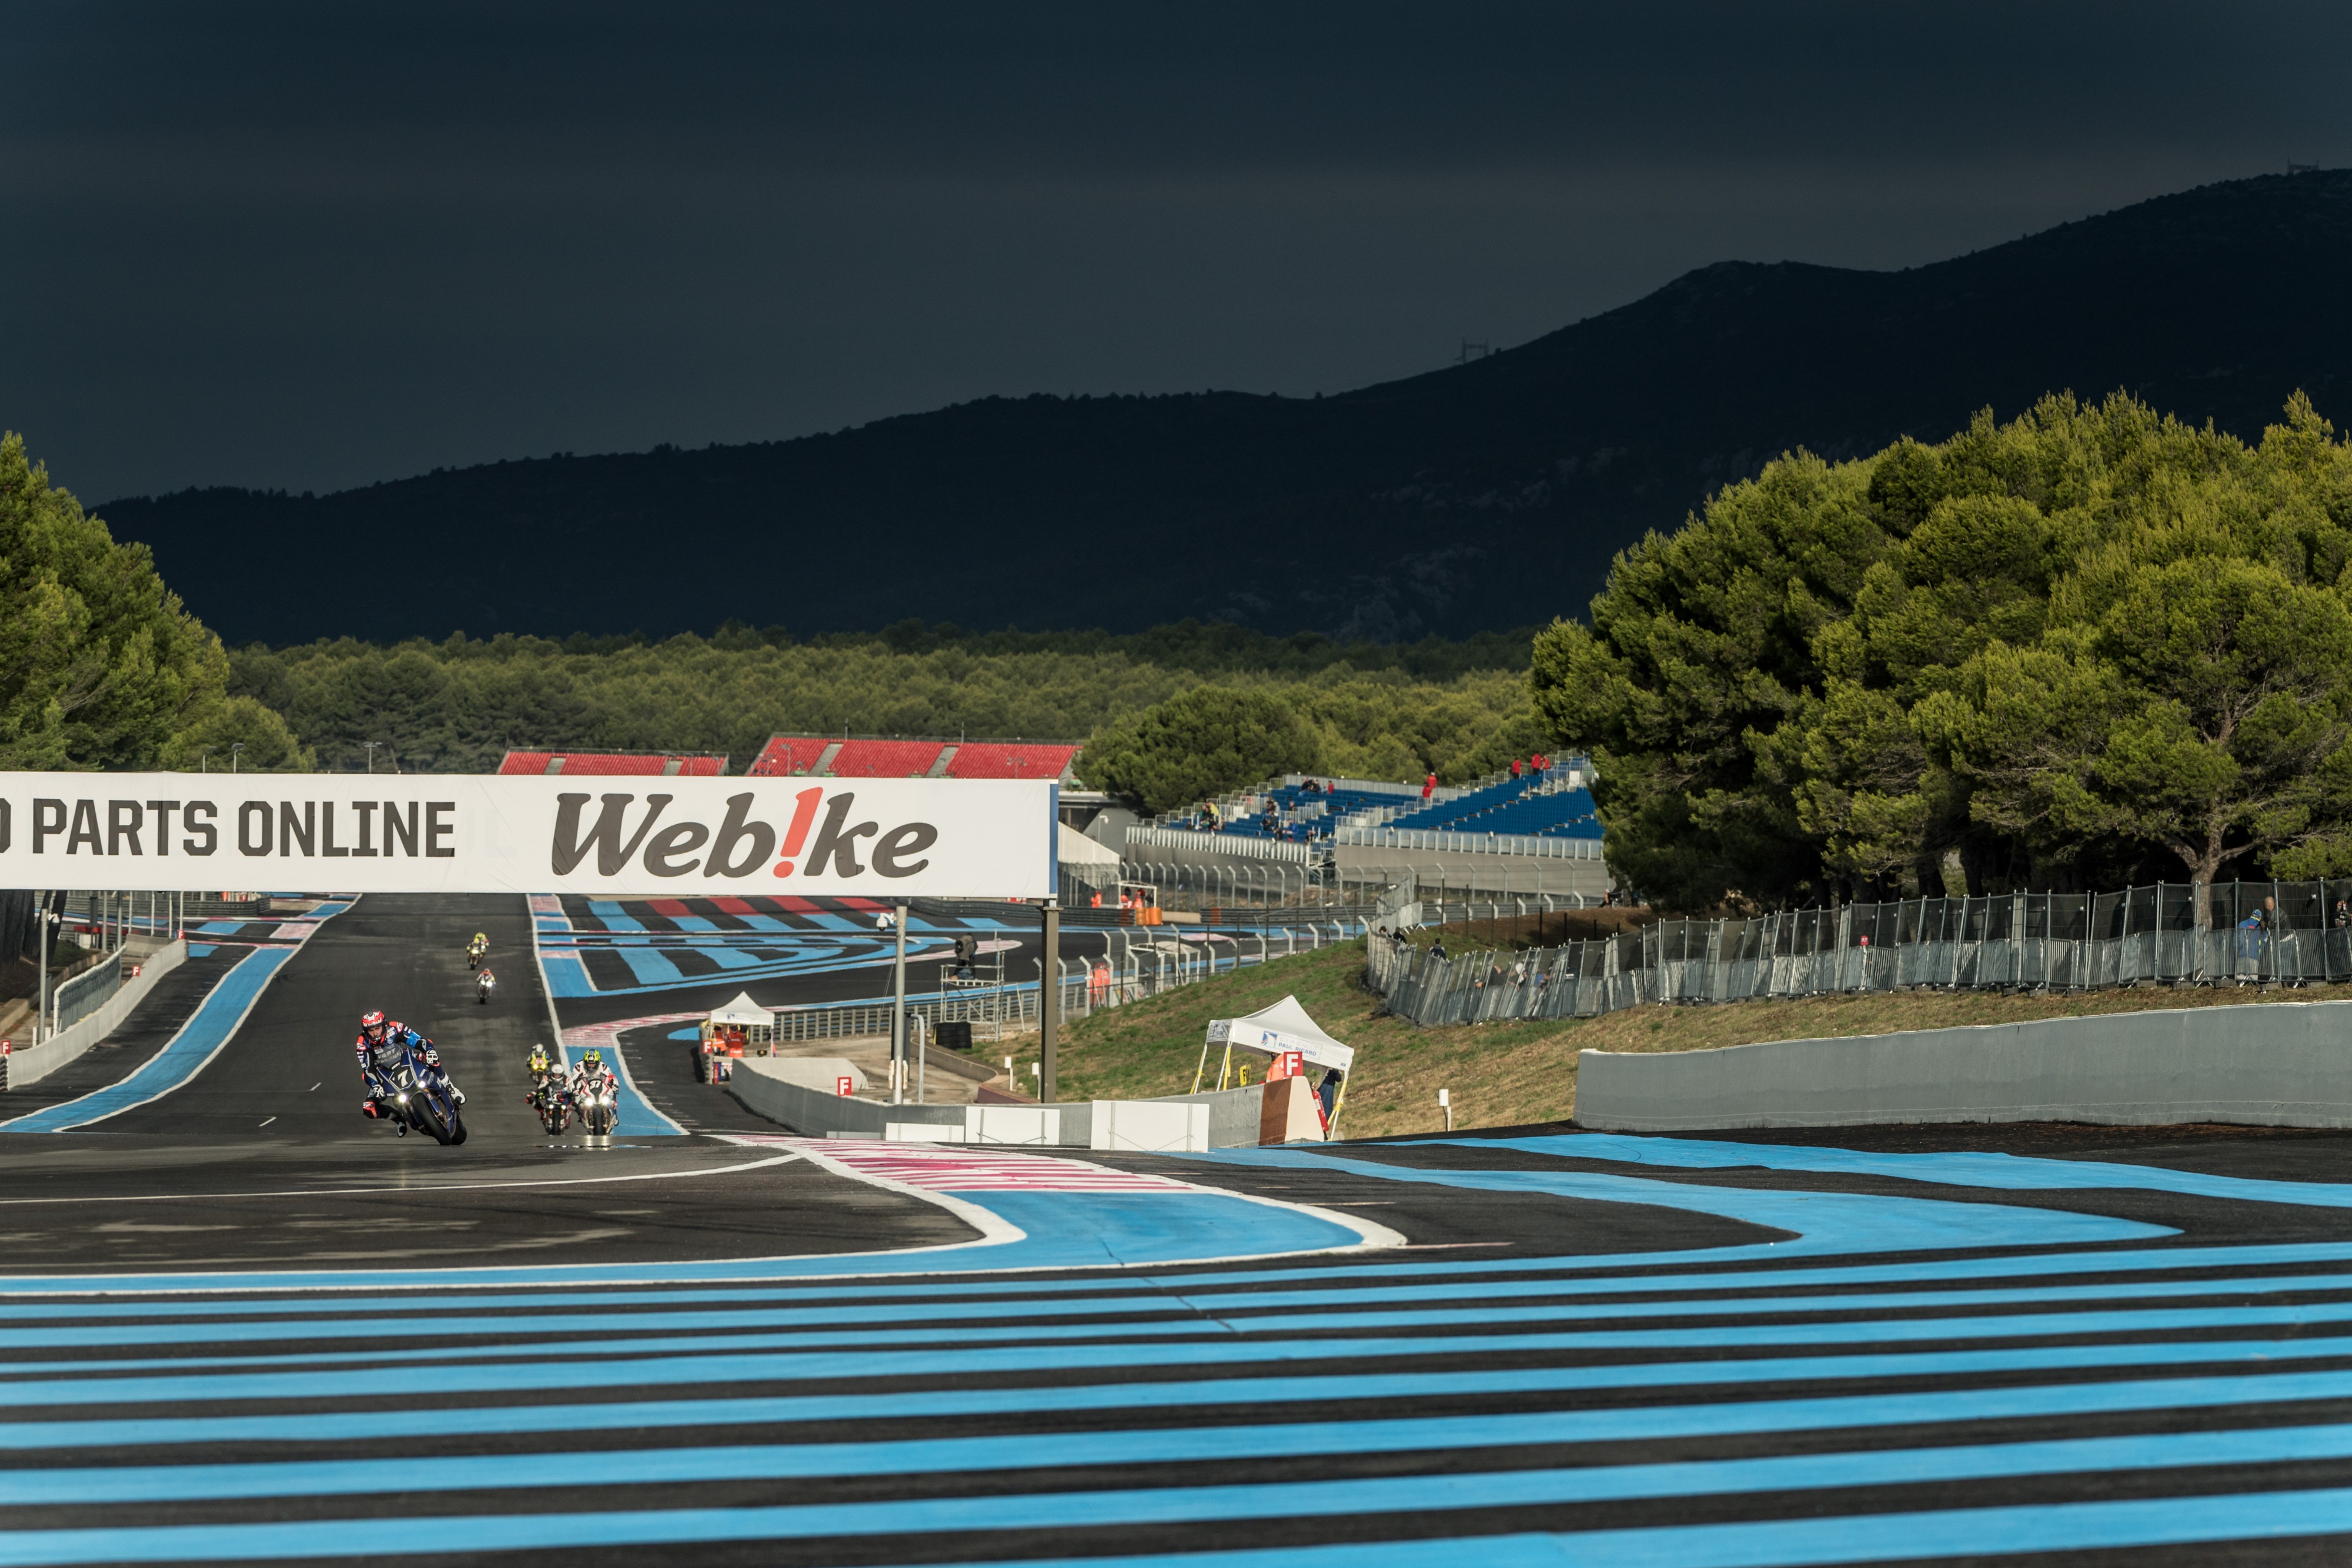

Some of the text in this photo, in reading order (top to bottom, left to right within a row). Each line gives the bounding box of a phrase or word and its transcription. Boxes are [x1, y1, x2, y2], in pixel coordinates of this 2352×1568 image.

[32, 798, 218, 856] PARTS
[238, 801, 455, 857] ONLINE
[178, 931, 183, 939] F
[133, 967, 139, 976] F
[3, 1042, 9, 1054] F
[704, 1041, 711, 1053] F
[1295, 1047, 1317, 1056] RICARD
[1287, 1054, 1298, 1075] F
[398, 1069, 408, 1087] 7
[590, 1080, 602, 1089] 37
[840, 1079, 849, 1095] F
